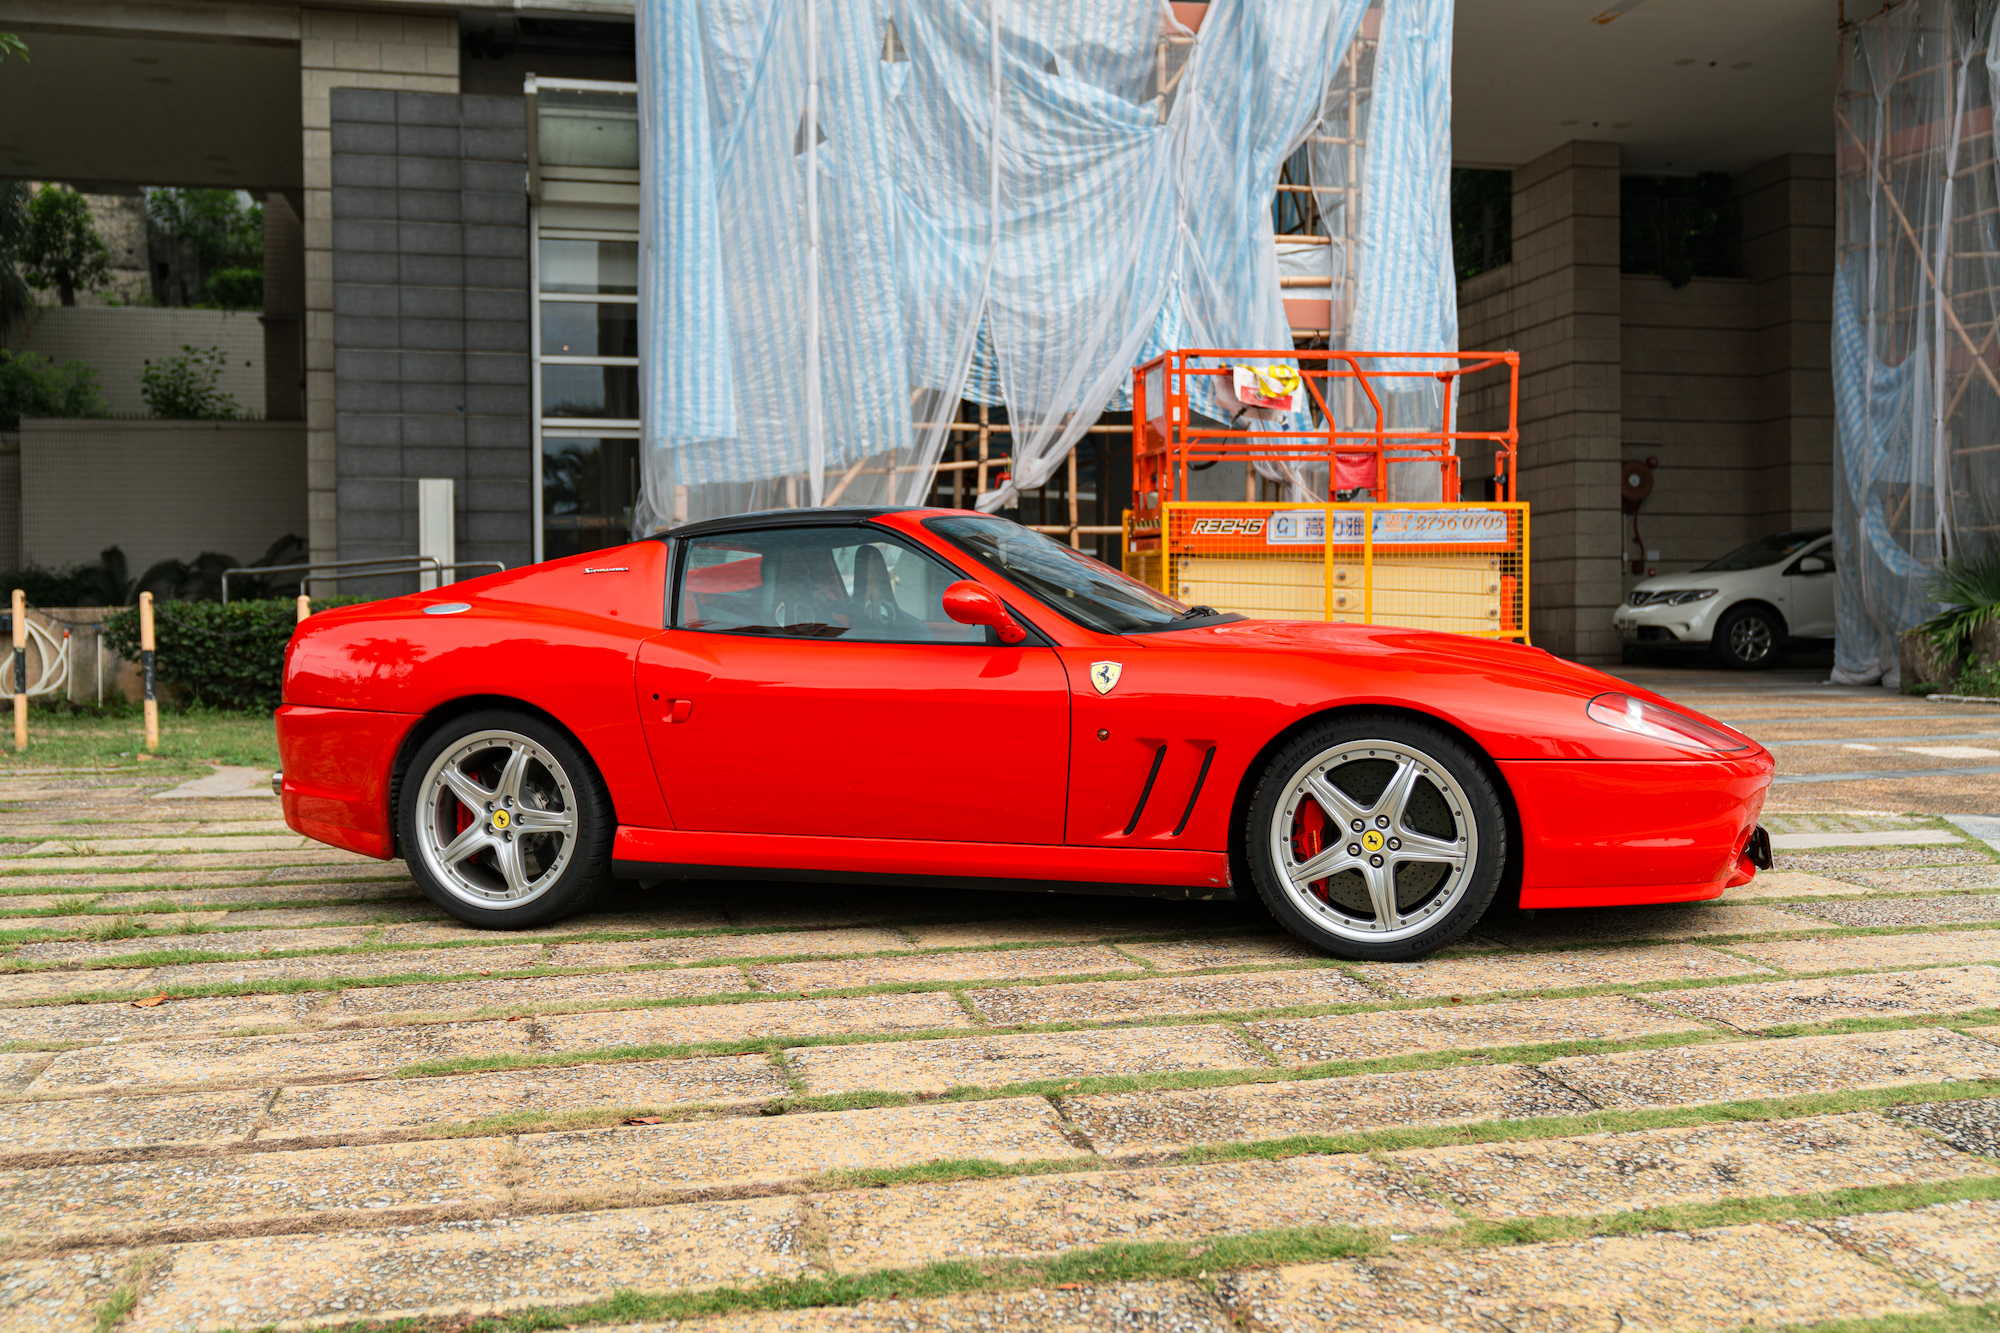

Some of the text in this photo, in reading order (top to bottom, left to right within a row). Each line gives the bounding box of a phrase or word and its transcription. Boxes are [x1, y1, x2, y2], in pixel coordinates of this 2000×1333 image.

[1191, 519, 1266, 535] R3246
[1416, 514, 1458, 531] 2756
[1462, 513, 1505, 530] 0705
[1285, 733, 1333, 769] MICHELIN
[1414, 914, 1462, 950] MICHELIN
